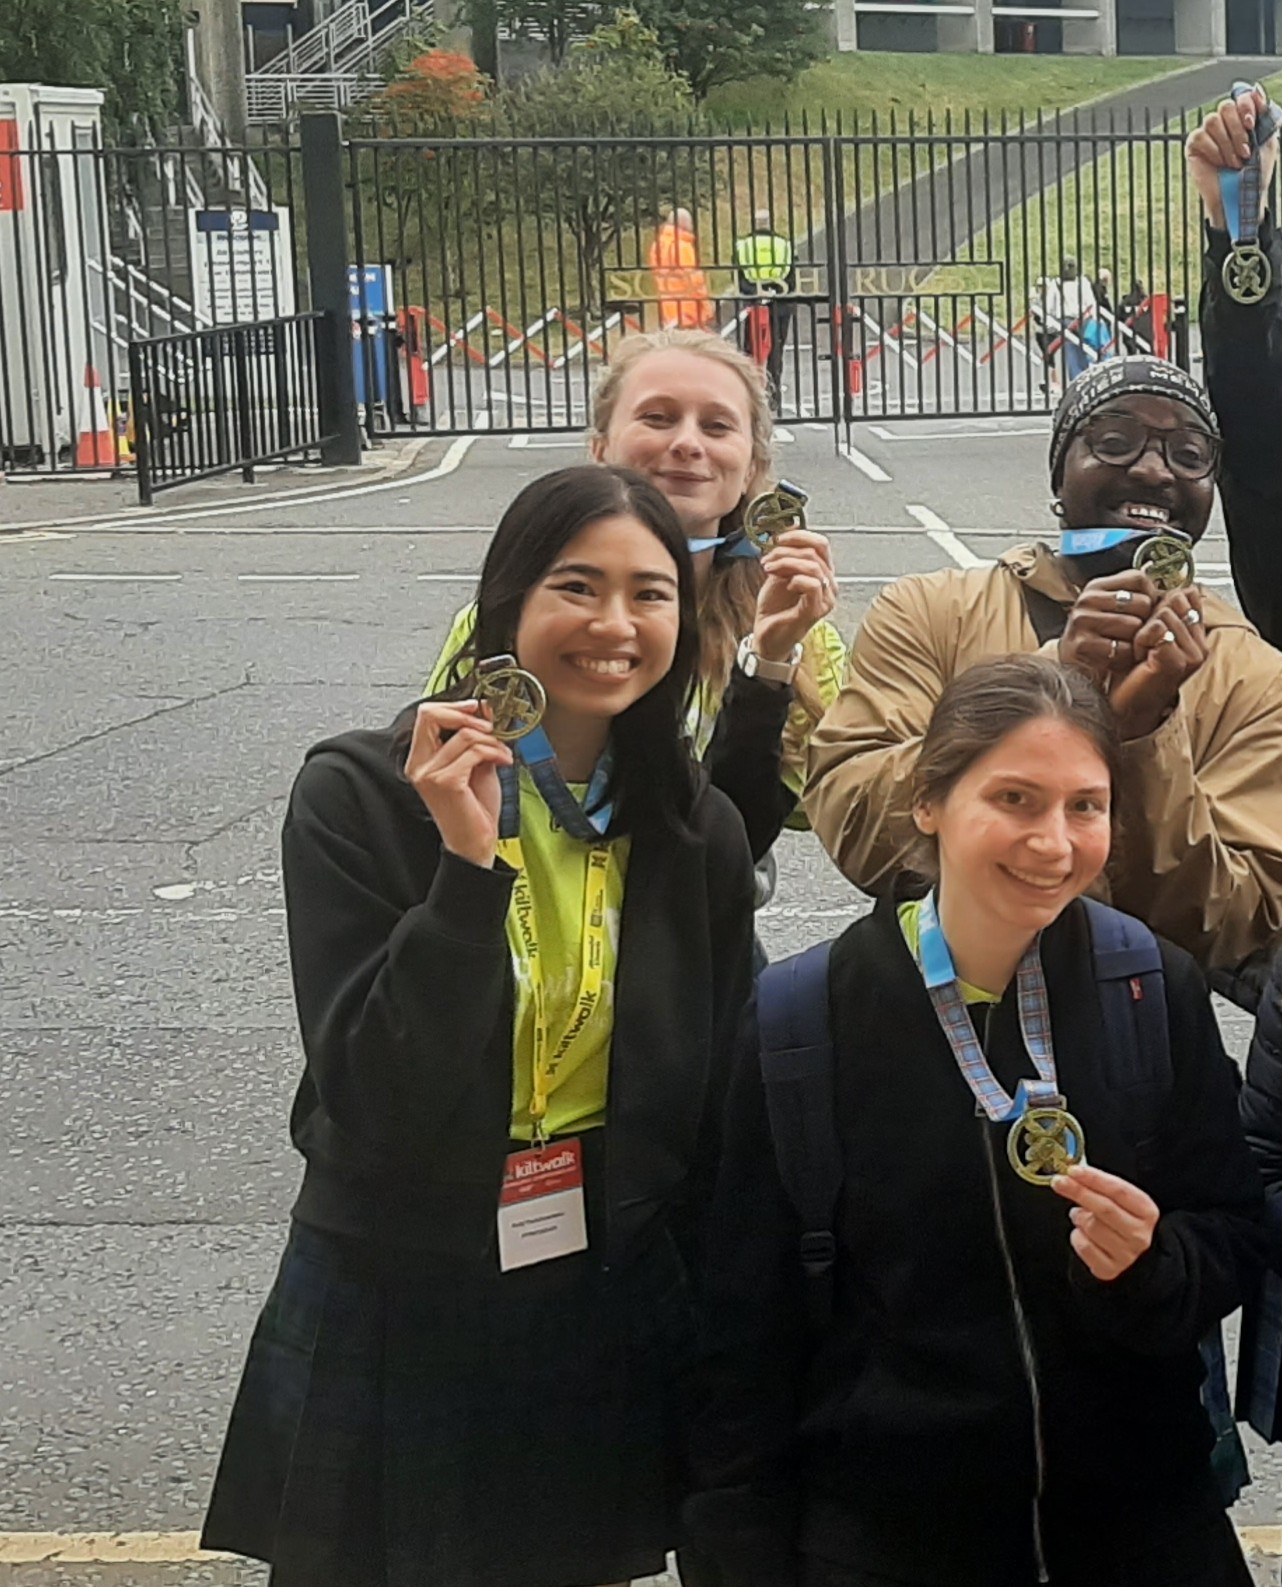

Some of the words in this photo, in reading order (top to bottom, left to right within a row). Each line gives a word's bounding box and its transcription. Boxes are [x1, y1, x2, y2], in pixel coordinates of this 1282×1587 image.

[609, 267, 820, 298] SCTTISH
[513, 883, 539, 959] kiltwalk
[552, 990, 598, 1060] kiltwalk
[514, 1150, 576, 1179] kiltwalk
